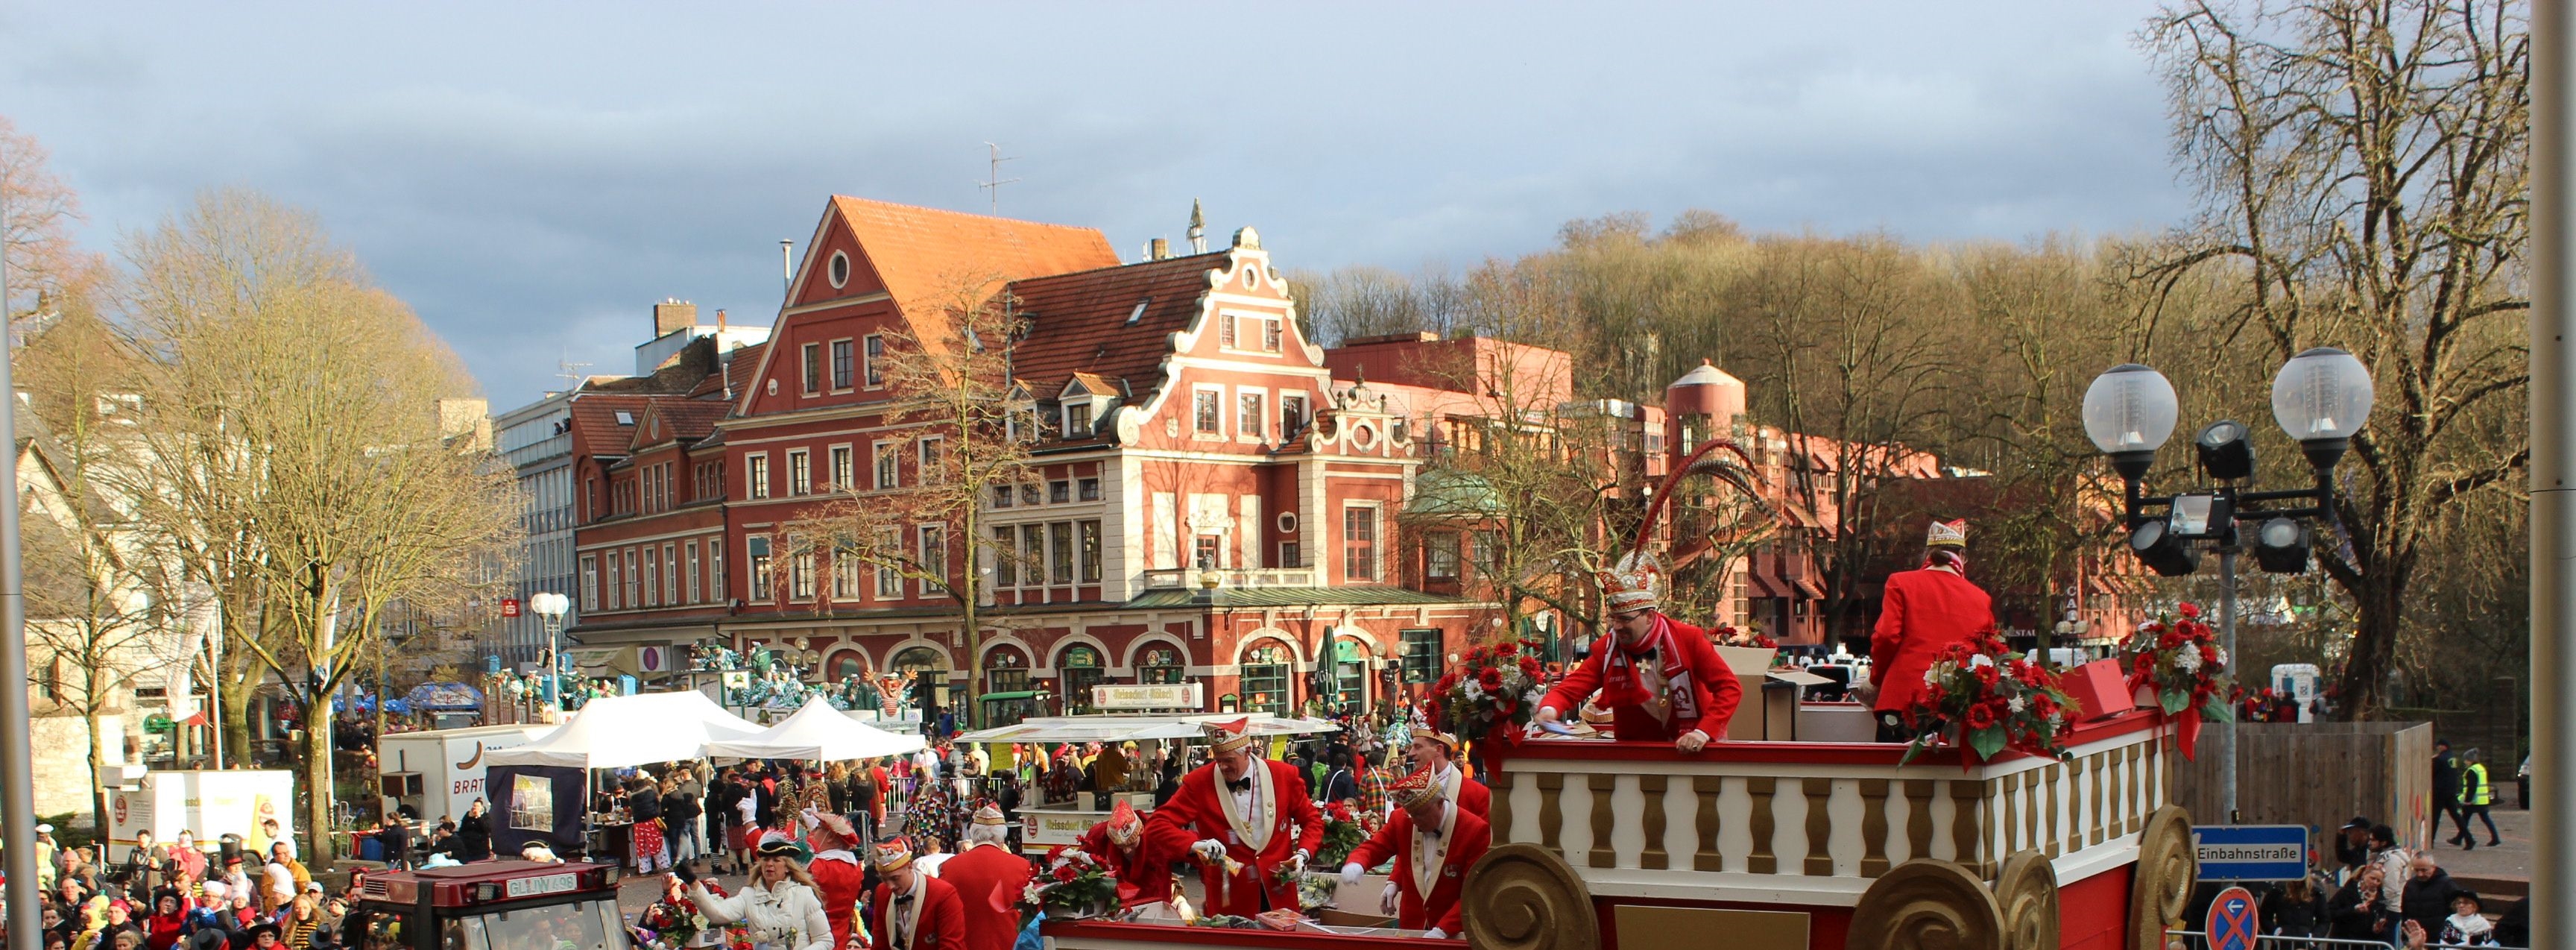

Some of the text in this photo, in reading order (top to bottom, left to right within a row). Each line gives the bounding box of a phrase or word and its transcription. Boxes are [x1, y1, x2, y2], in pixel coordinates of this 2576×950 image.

[453, 778, 484, 795] BRAT
[1045, 819, 1080, 831] Reissdorf
[2197, 847, 2297, 860] Einbahnstraße
